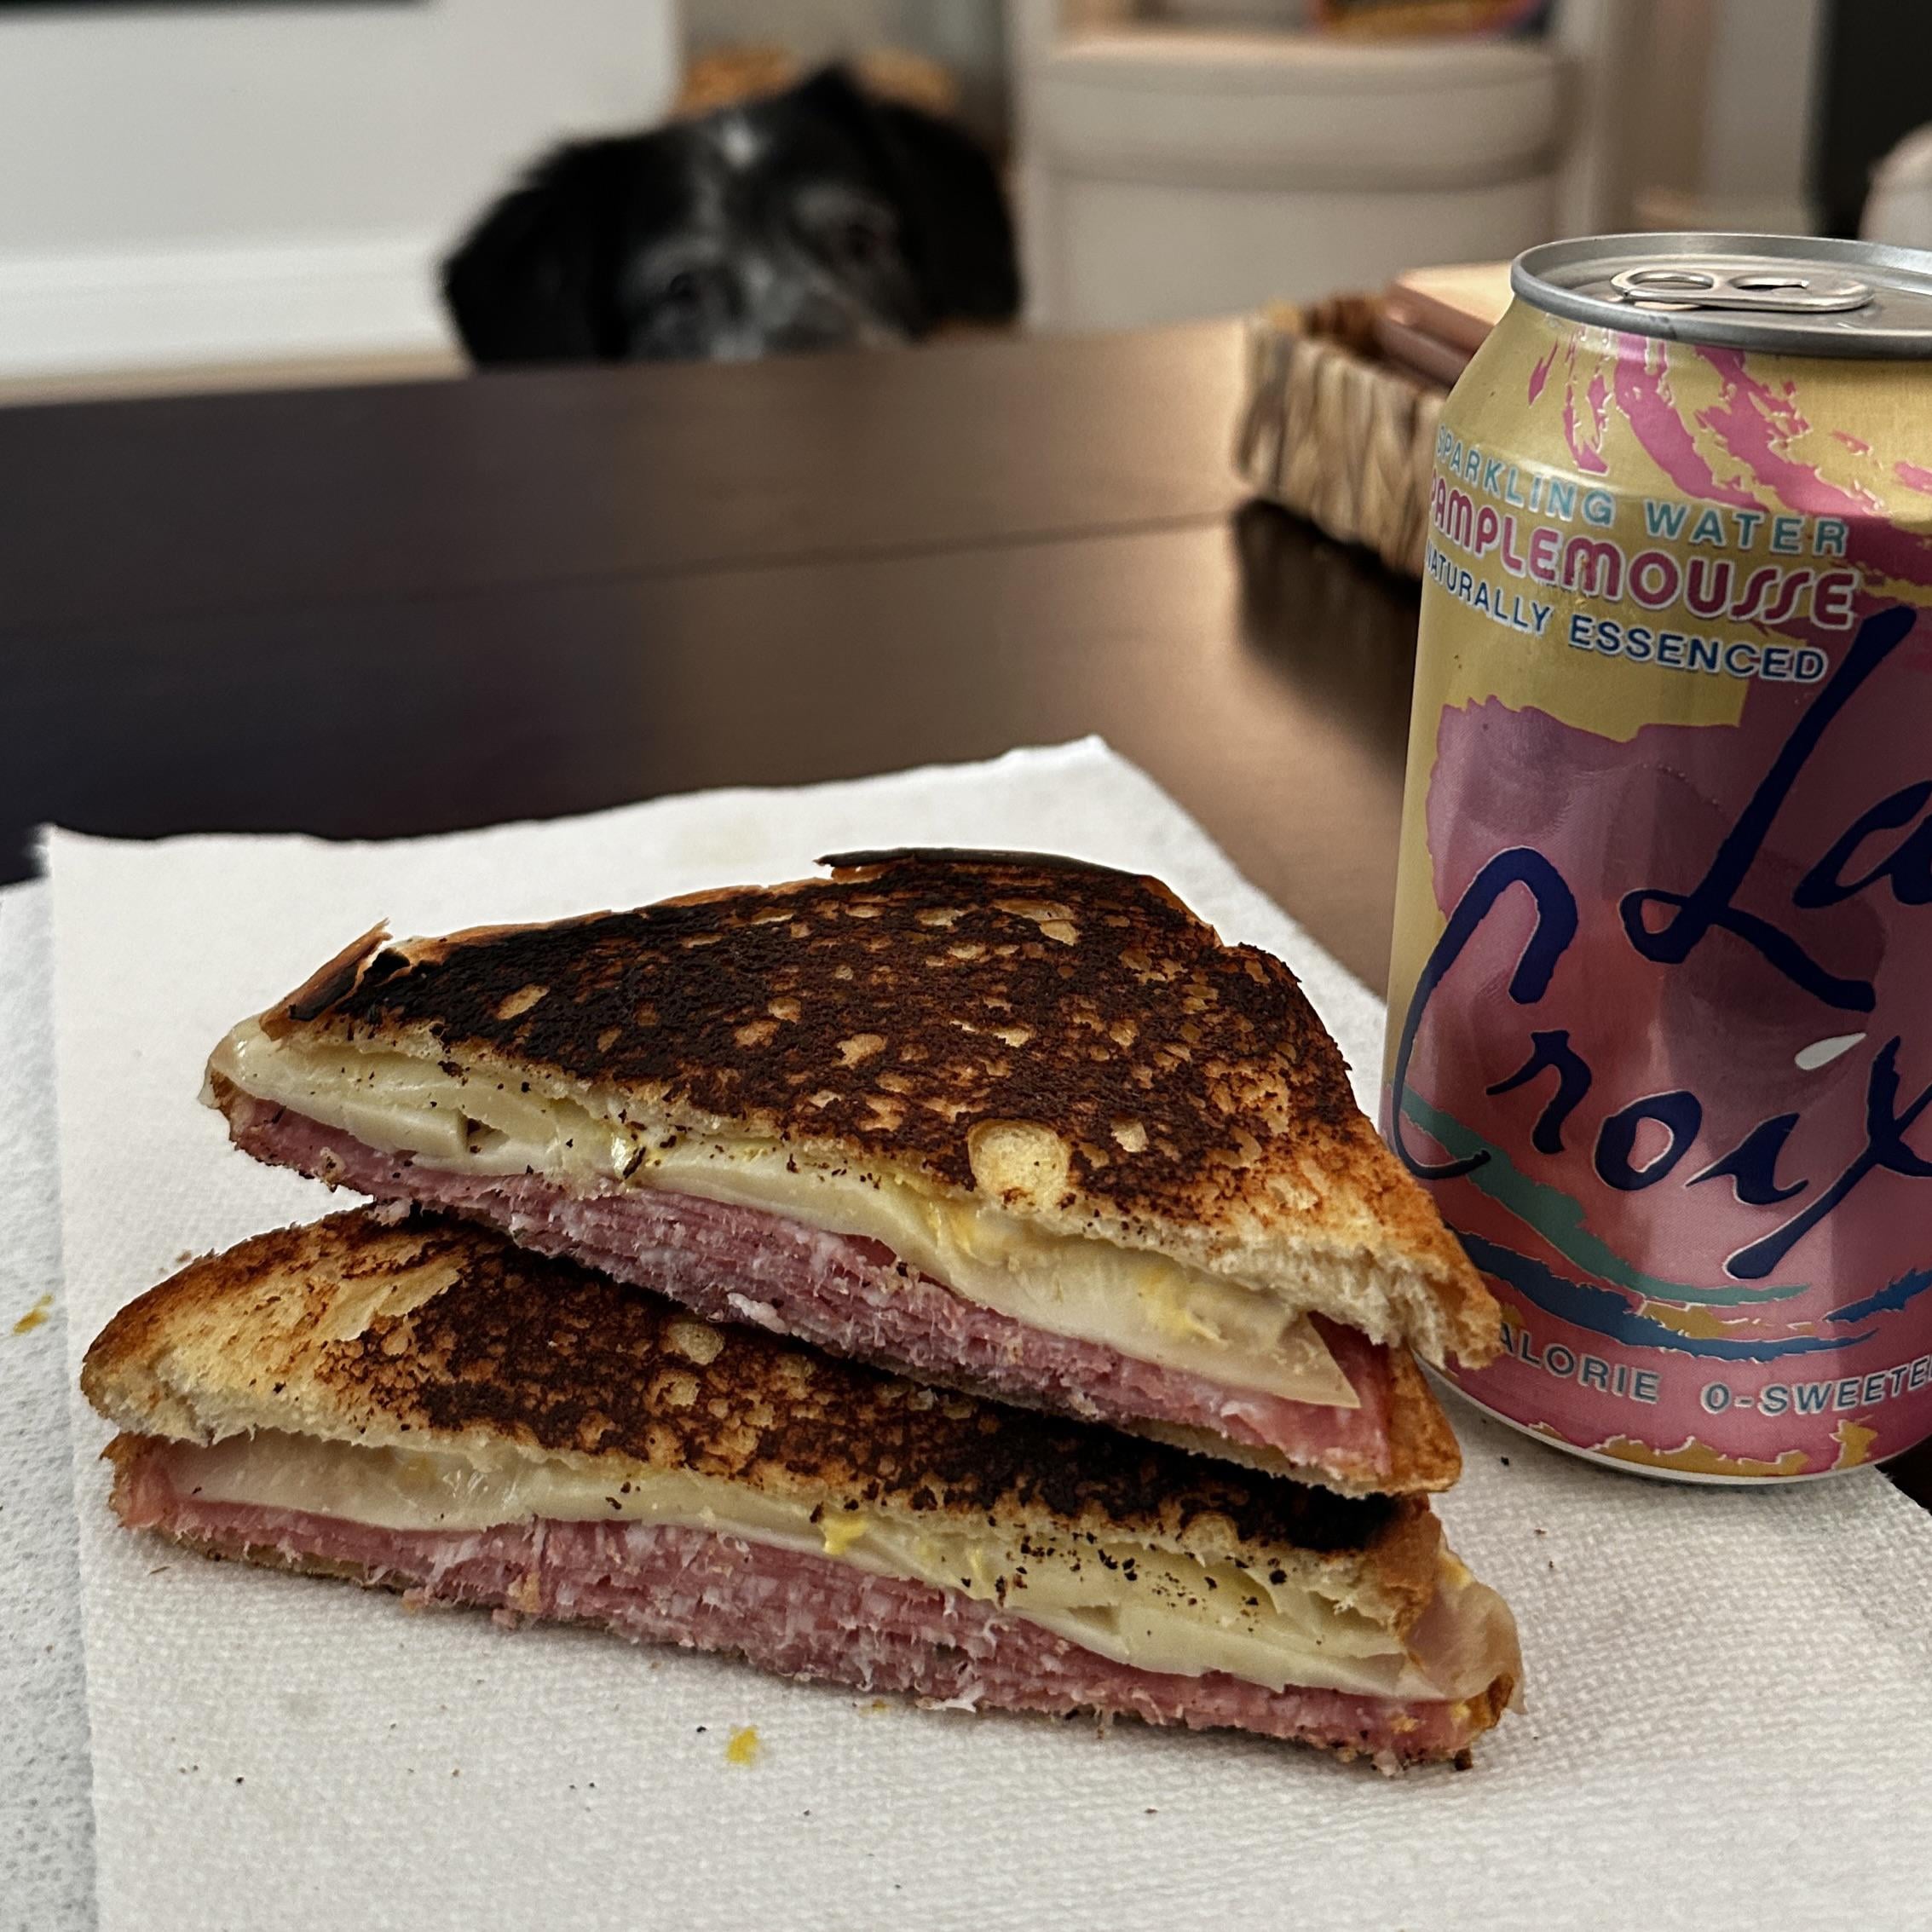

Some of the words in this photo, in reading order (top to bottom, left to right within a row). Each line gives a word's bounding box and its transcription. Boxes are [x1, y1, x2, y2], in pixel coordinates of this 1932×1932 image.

[1438, 425, 1615, 527] SPARKLING
[1646, 500, 1848, 556] WATER
[1427, 538, 1553, 633] NATURALLY
[1567, 613, 1828, 682] ESSENCED
[1618, 606, 1932, 1012] La
[1392, 846, 1932, 1280] Croix
[1500, 1321, 1658, 1404] ALORIE
[1700, 1355, 1932, 1417] 0-SWEETE
